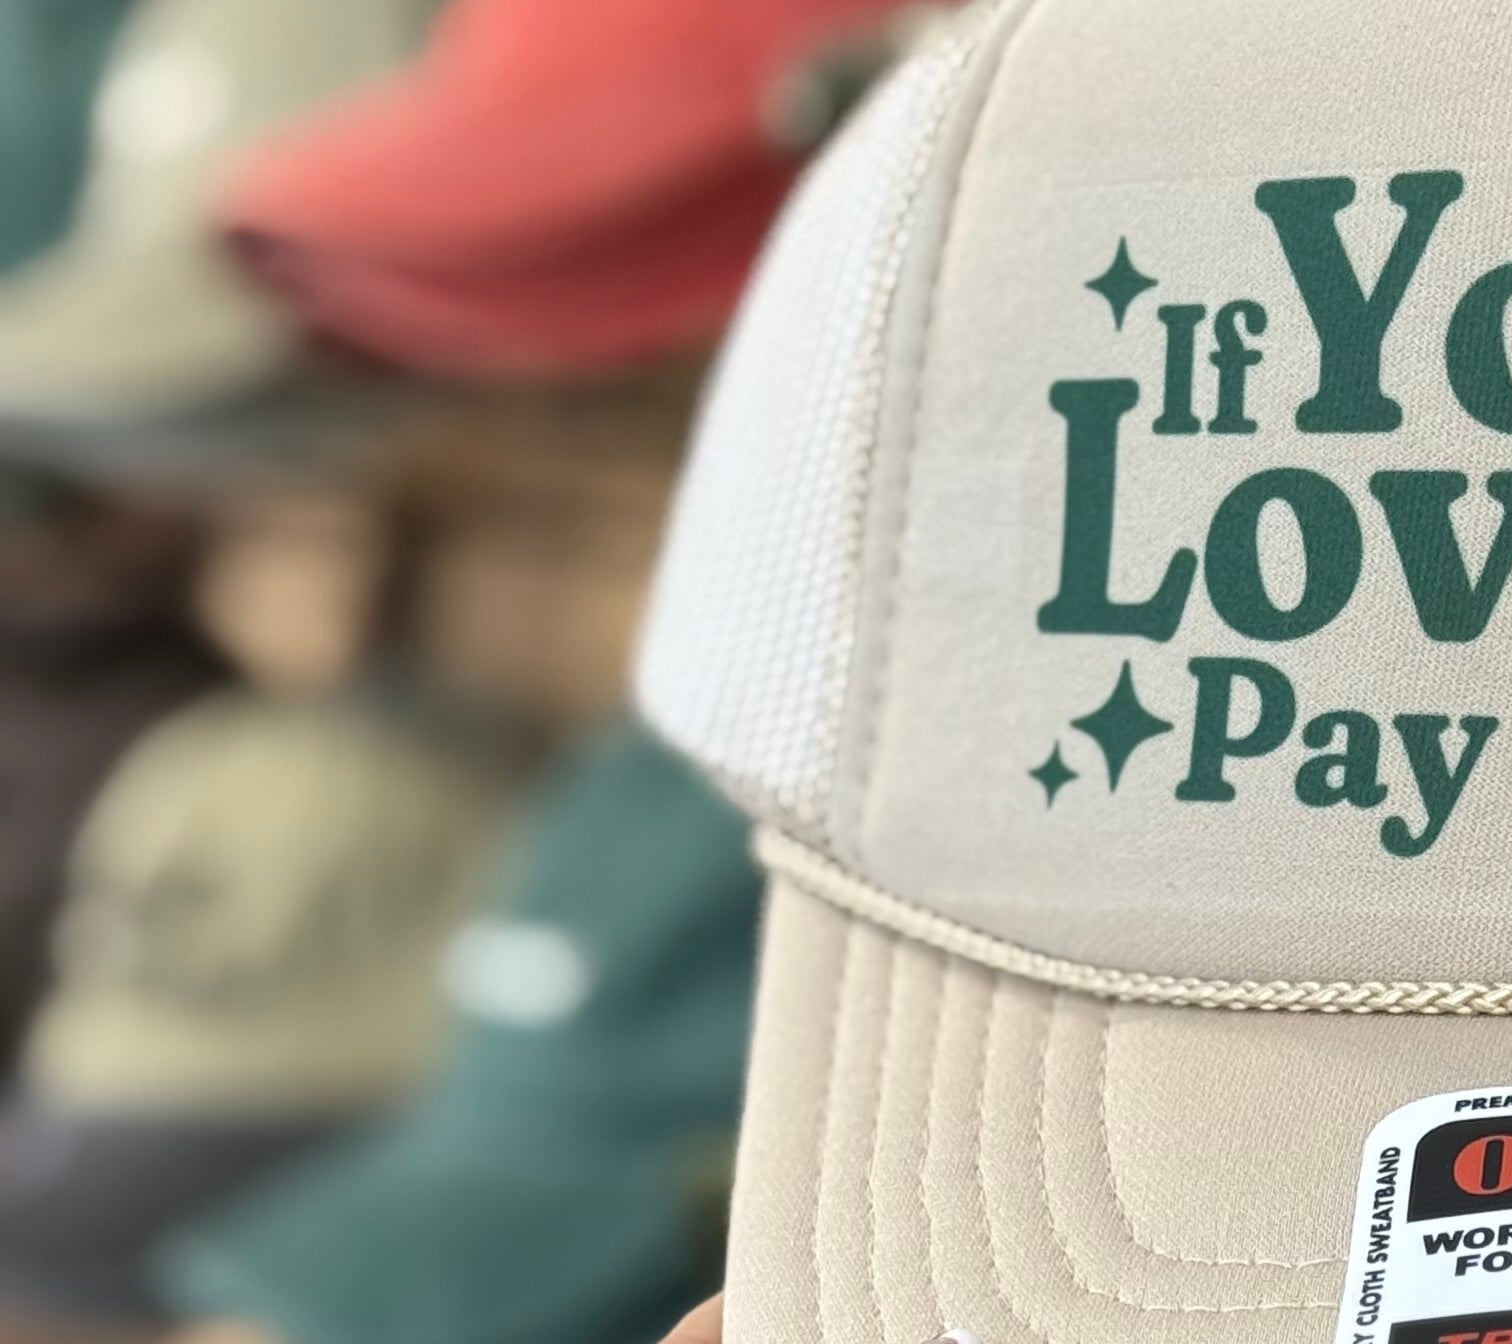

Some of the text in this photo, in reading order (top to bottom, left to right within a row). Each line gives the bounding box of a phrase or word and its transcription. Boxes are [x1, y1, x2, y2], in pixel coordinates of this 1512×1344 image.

[1152, 299, 1269, 436] If
[1174, 655, 1500, 859] Pay
[1367, 1146, 1401, 1264] SWEATBAND
[1356, 1269, 1386, 1326] CLOTH
